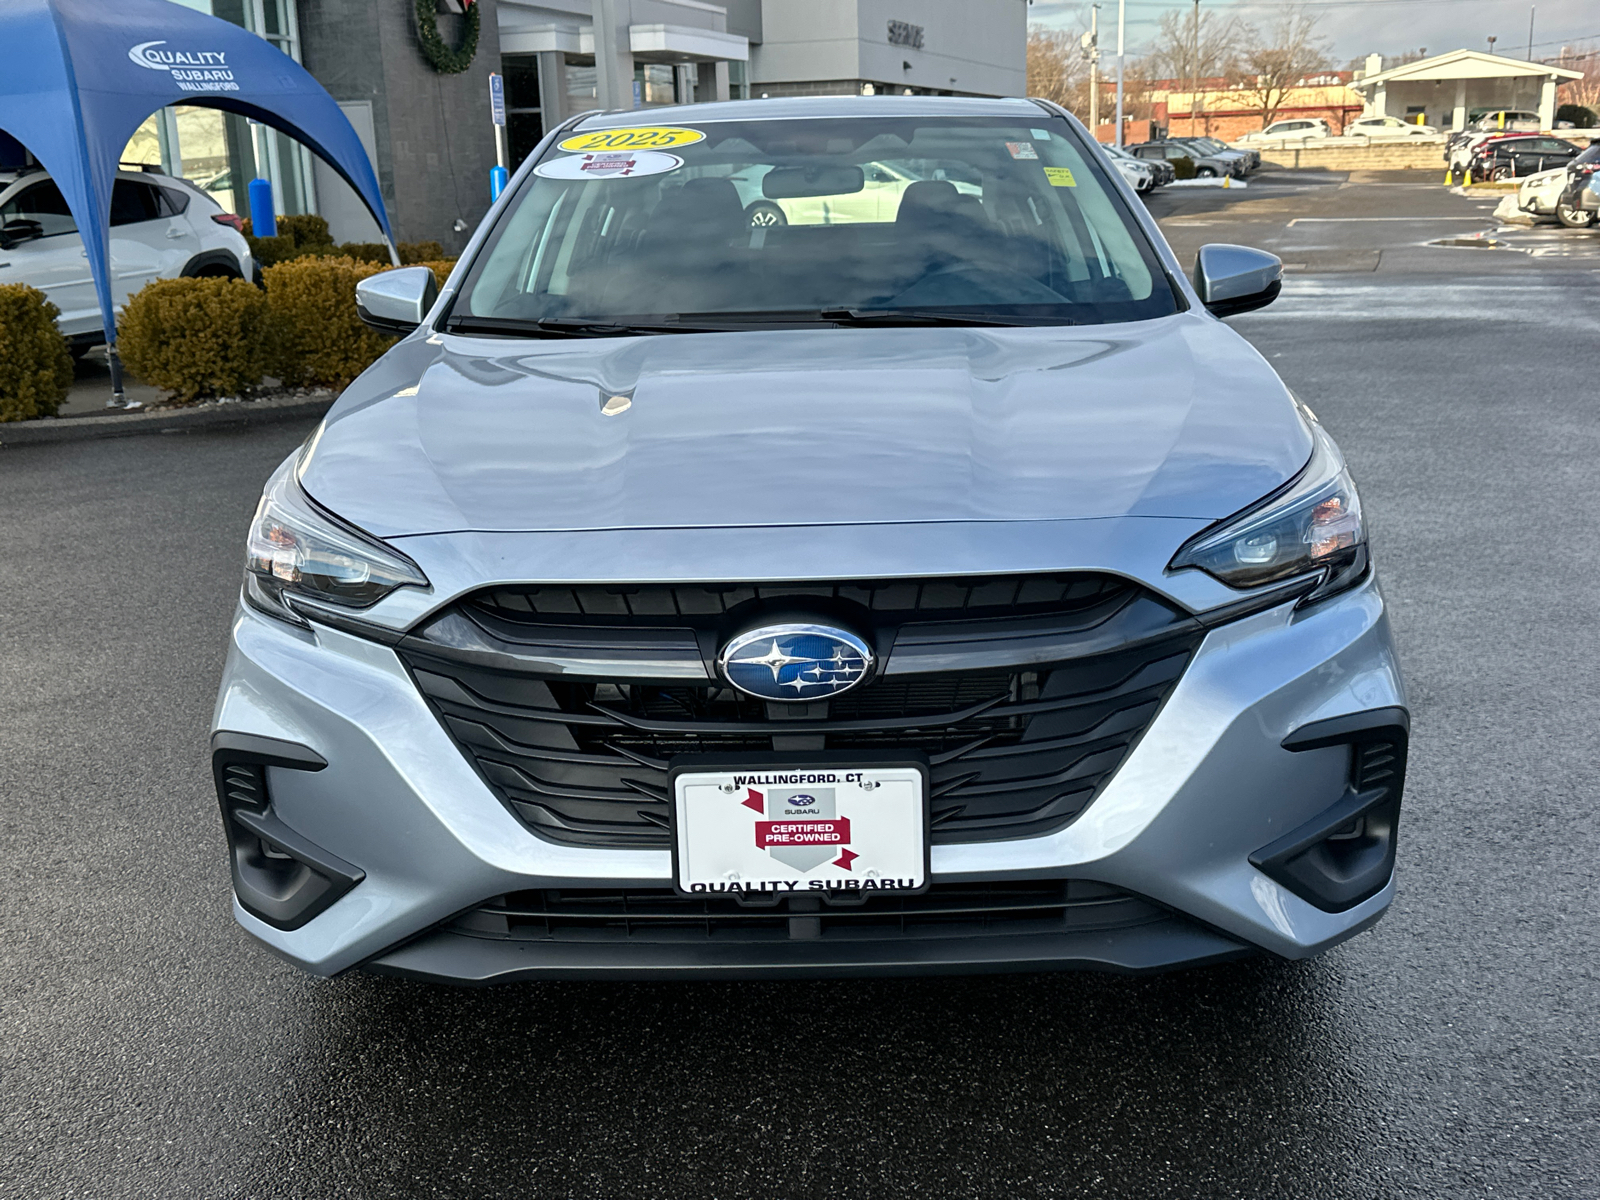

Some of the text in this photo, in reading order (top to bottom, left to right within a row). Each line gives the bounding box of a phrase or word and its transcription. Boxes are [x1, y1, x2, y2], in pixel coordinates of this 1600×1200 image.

[145, 50, 225, 64] QUALITY
[171, 69, 234, 81] SUBARU
[176, 81, 240, 91] WALLINGFORD
[579, 131, 685, 150] 2025
[845, 773, 863, 783] CT
[771, 823, 835, 833] CERTIFIED
[766, 832, 841, 843] PRE-OWNED
[690, 878, 914, 893] QUALITY SUBARU
